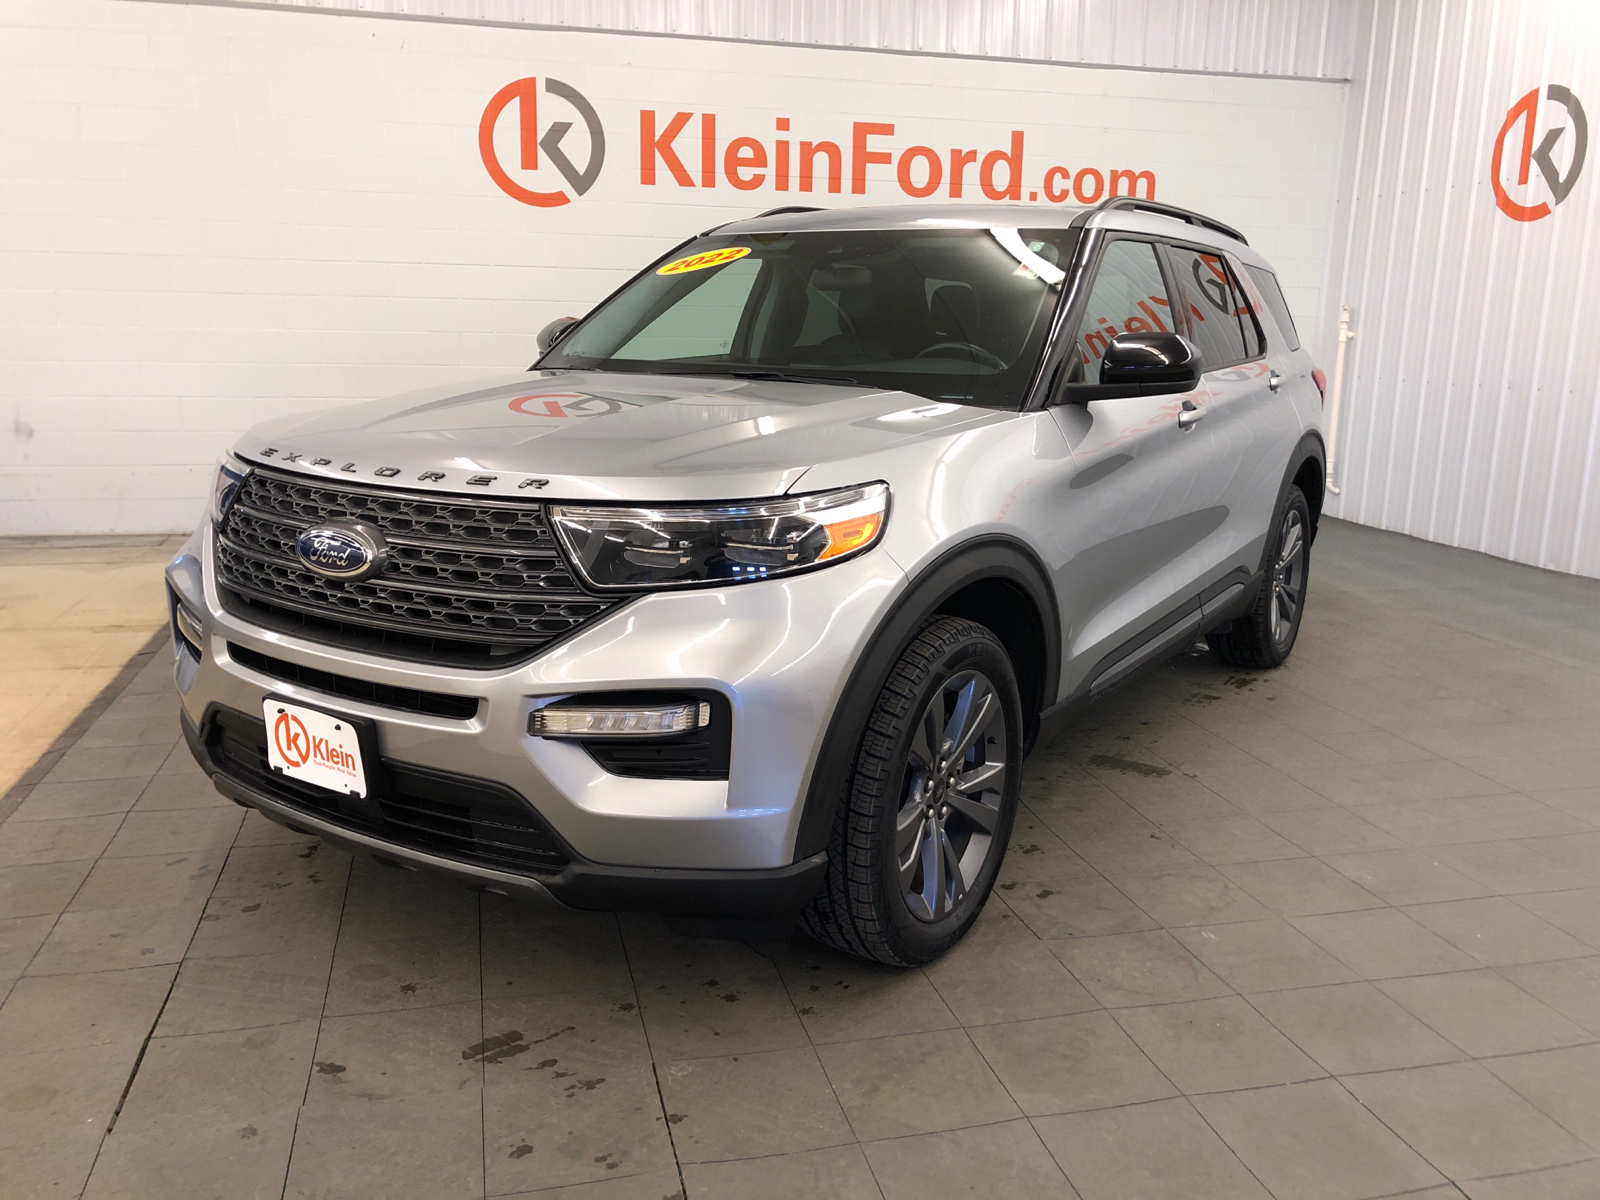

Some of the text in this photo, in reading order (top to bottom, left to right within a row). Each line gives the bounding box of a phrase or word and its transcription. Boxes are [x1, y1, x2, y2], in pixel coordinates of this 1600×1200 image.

[639, 109, 1157, 203] KleinFord.com
[664, 249, 744, 272] 2022
[259, 446, 550, 490] EXPLORER
[308, 537, 350, 567] Ford
[312, 735, 356, 771] Klein
